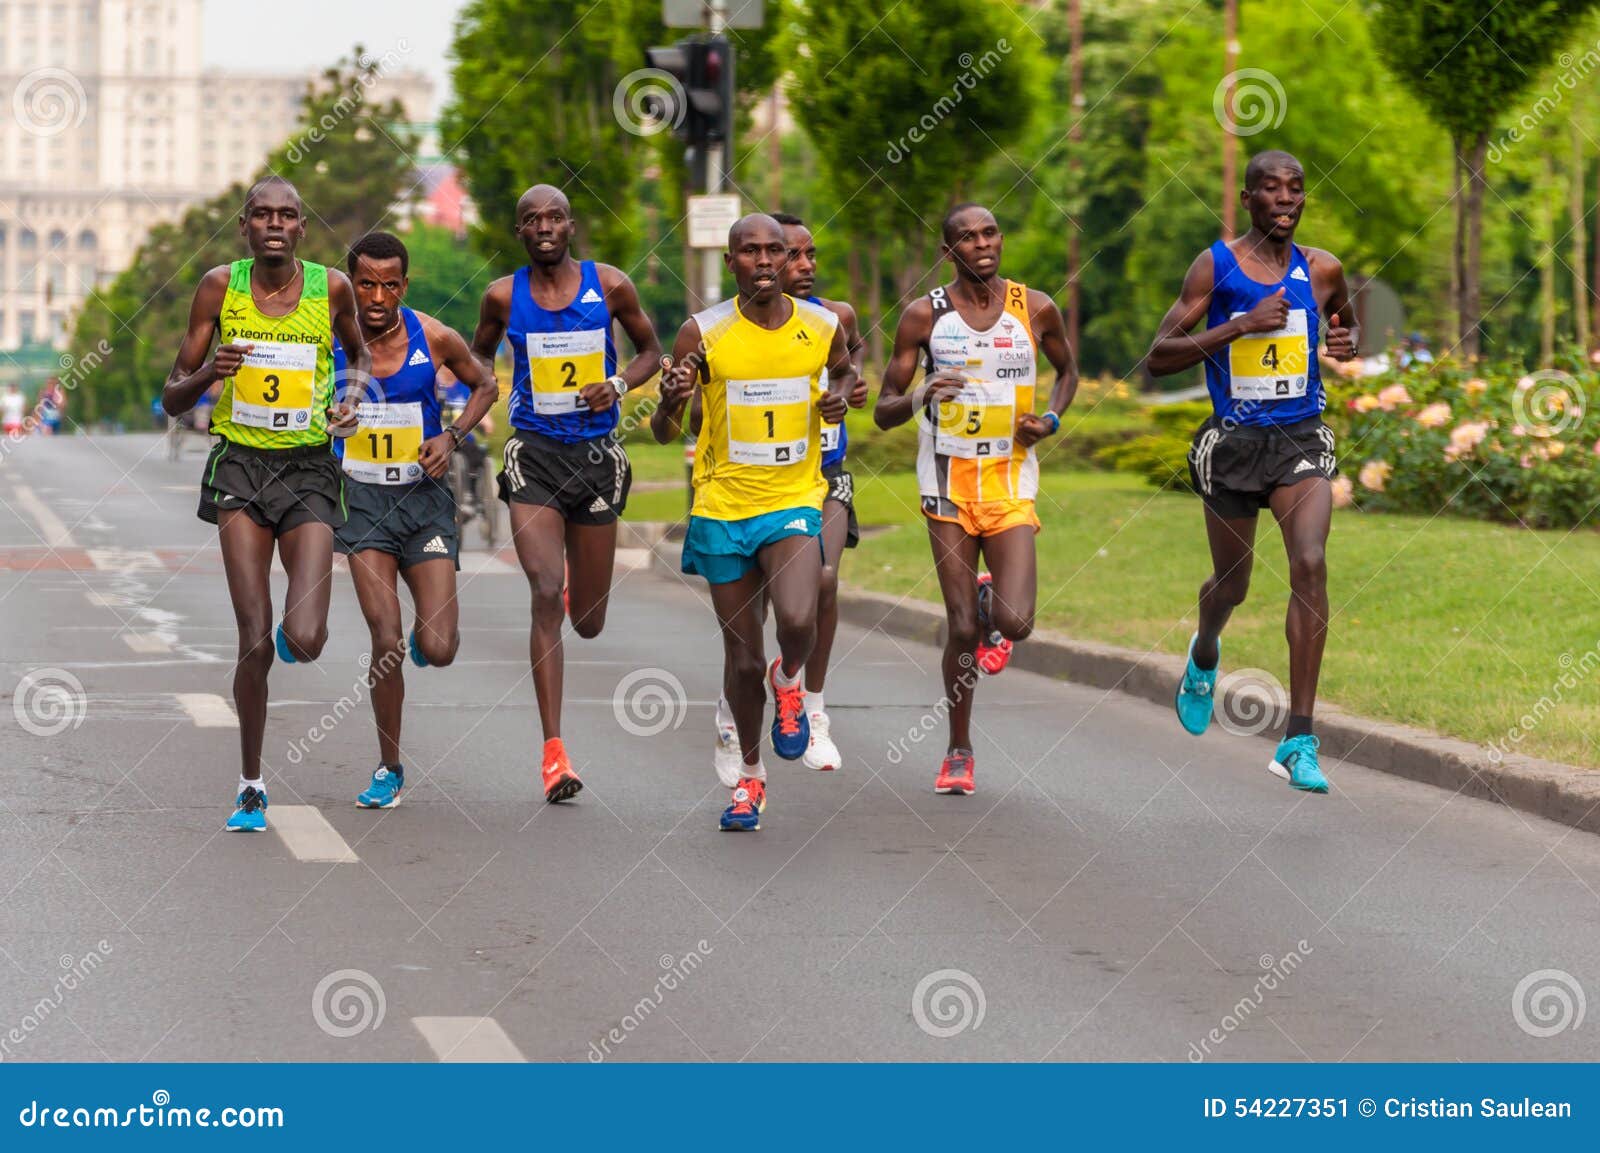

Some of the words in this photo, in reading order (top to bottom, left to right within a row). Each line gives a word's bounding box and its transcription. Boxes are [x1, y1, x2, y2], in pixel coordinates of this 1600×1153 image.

[240, 328, 273, 341] team
[1262, 344, 1279, 371] 4
[561, 361, 577, 388] 2
[262, 374, 280, 403] 3
[764, 411, 775, 438] 1
[966, 410, 981, 435] 5
[368, 433, 393, 459] 11
